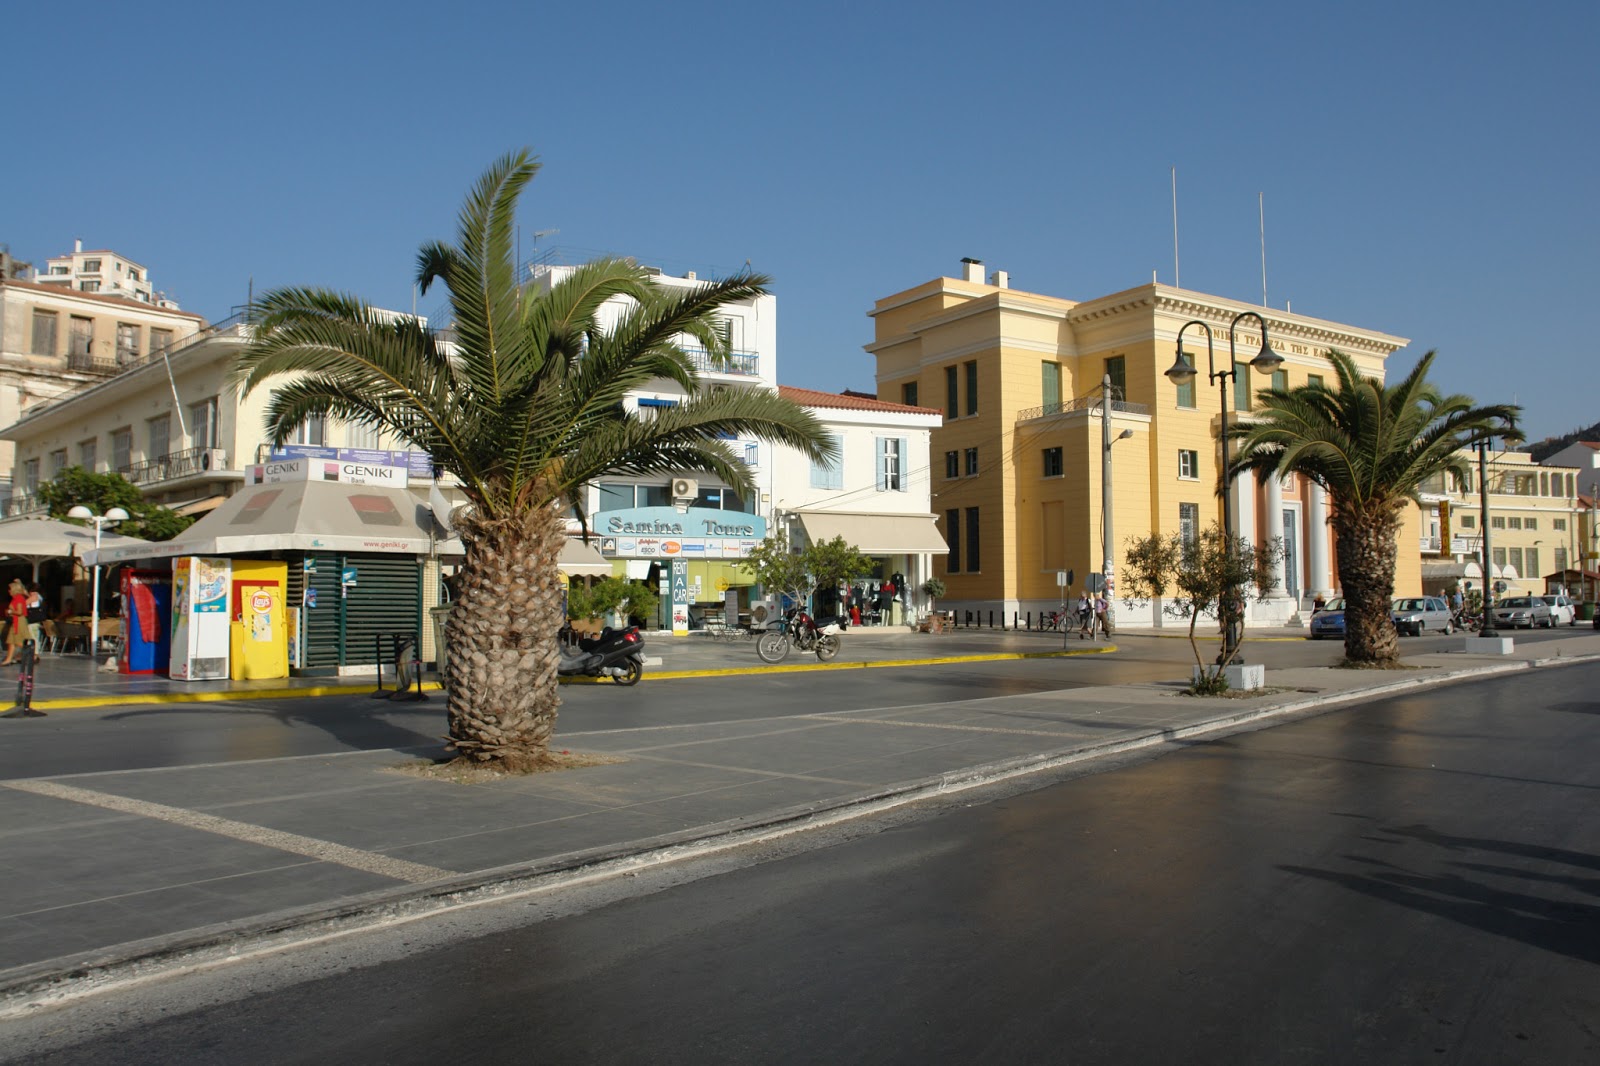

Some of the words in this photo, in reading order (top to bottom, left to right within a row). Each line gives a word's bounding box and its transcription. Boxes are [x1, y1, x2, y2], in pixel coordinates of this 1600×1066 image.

[1244, 335, 1285, 351] ΤΡΑΕΖΑ
[1290, 344, 1309, 355] ΤΗΣ
[266, 462, 299, 475] GENIKI
[343, 464, 393, 479] GENIKI
[608, 516, 684, 535] Samina
[701, 519, 754, 537] Tours
[363, 541, 408, 549] www.geniki.gr
[673, 562, 687, 575] RENT
[675, 577, 684, 587] A
[673, 589, 687, 602] CAR
